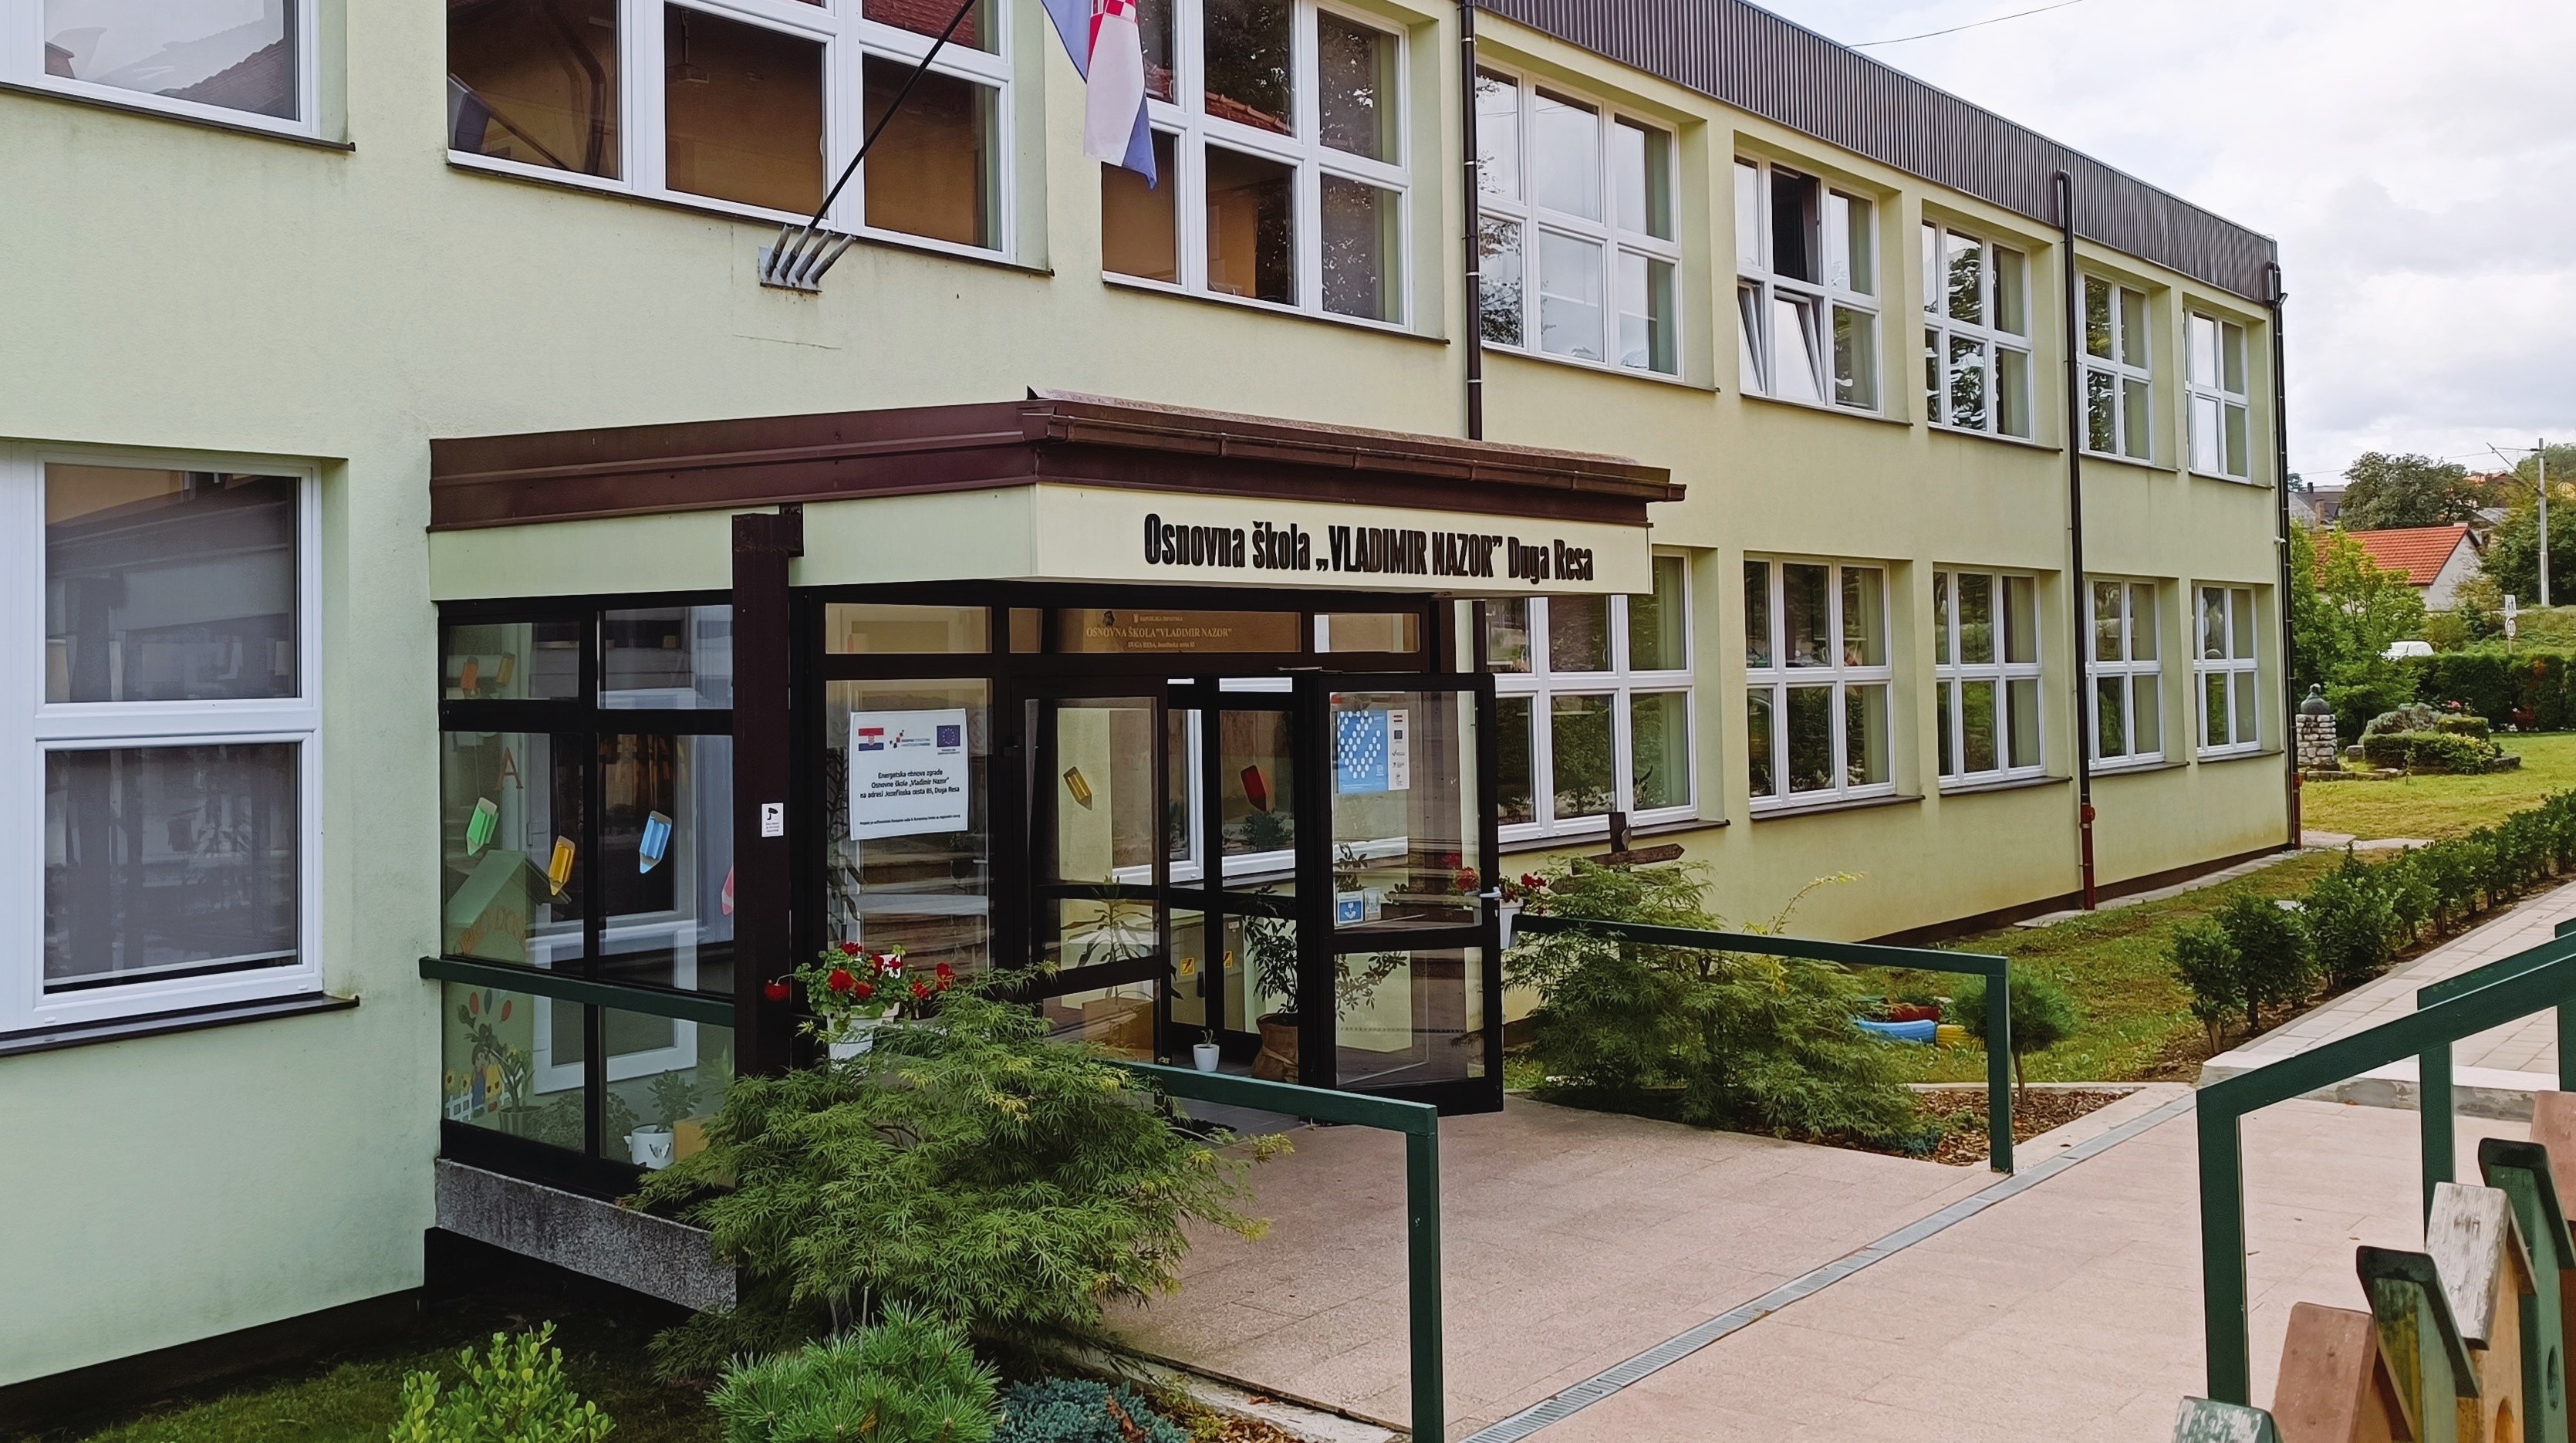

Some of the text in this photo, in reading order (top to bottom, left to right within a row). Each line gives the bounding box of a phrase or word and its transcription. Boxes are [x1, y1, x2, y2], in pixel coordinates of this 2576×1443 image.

[1144, 512, 1246, 568] Osnovna
[1251, 520, 1311, 571] škola
[1315, 525, 1428, 575] „VLADIMIR
[1507, 536, 1551, 585] Duga
[1553, 539, 1594, 581] Resa
[1086, 627, 1127, 637] OSNOVNA
[878, 771, 906, 779] Energetska
[927, 769, 943, 777] zgrade
[884, 789, 911, 797] Jozefinska
